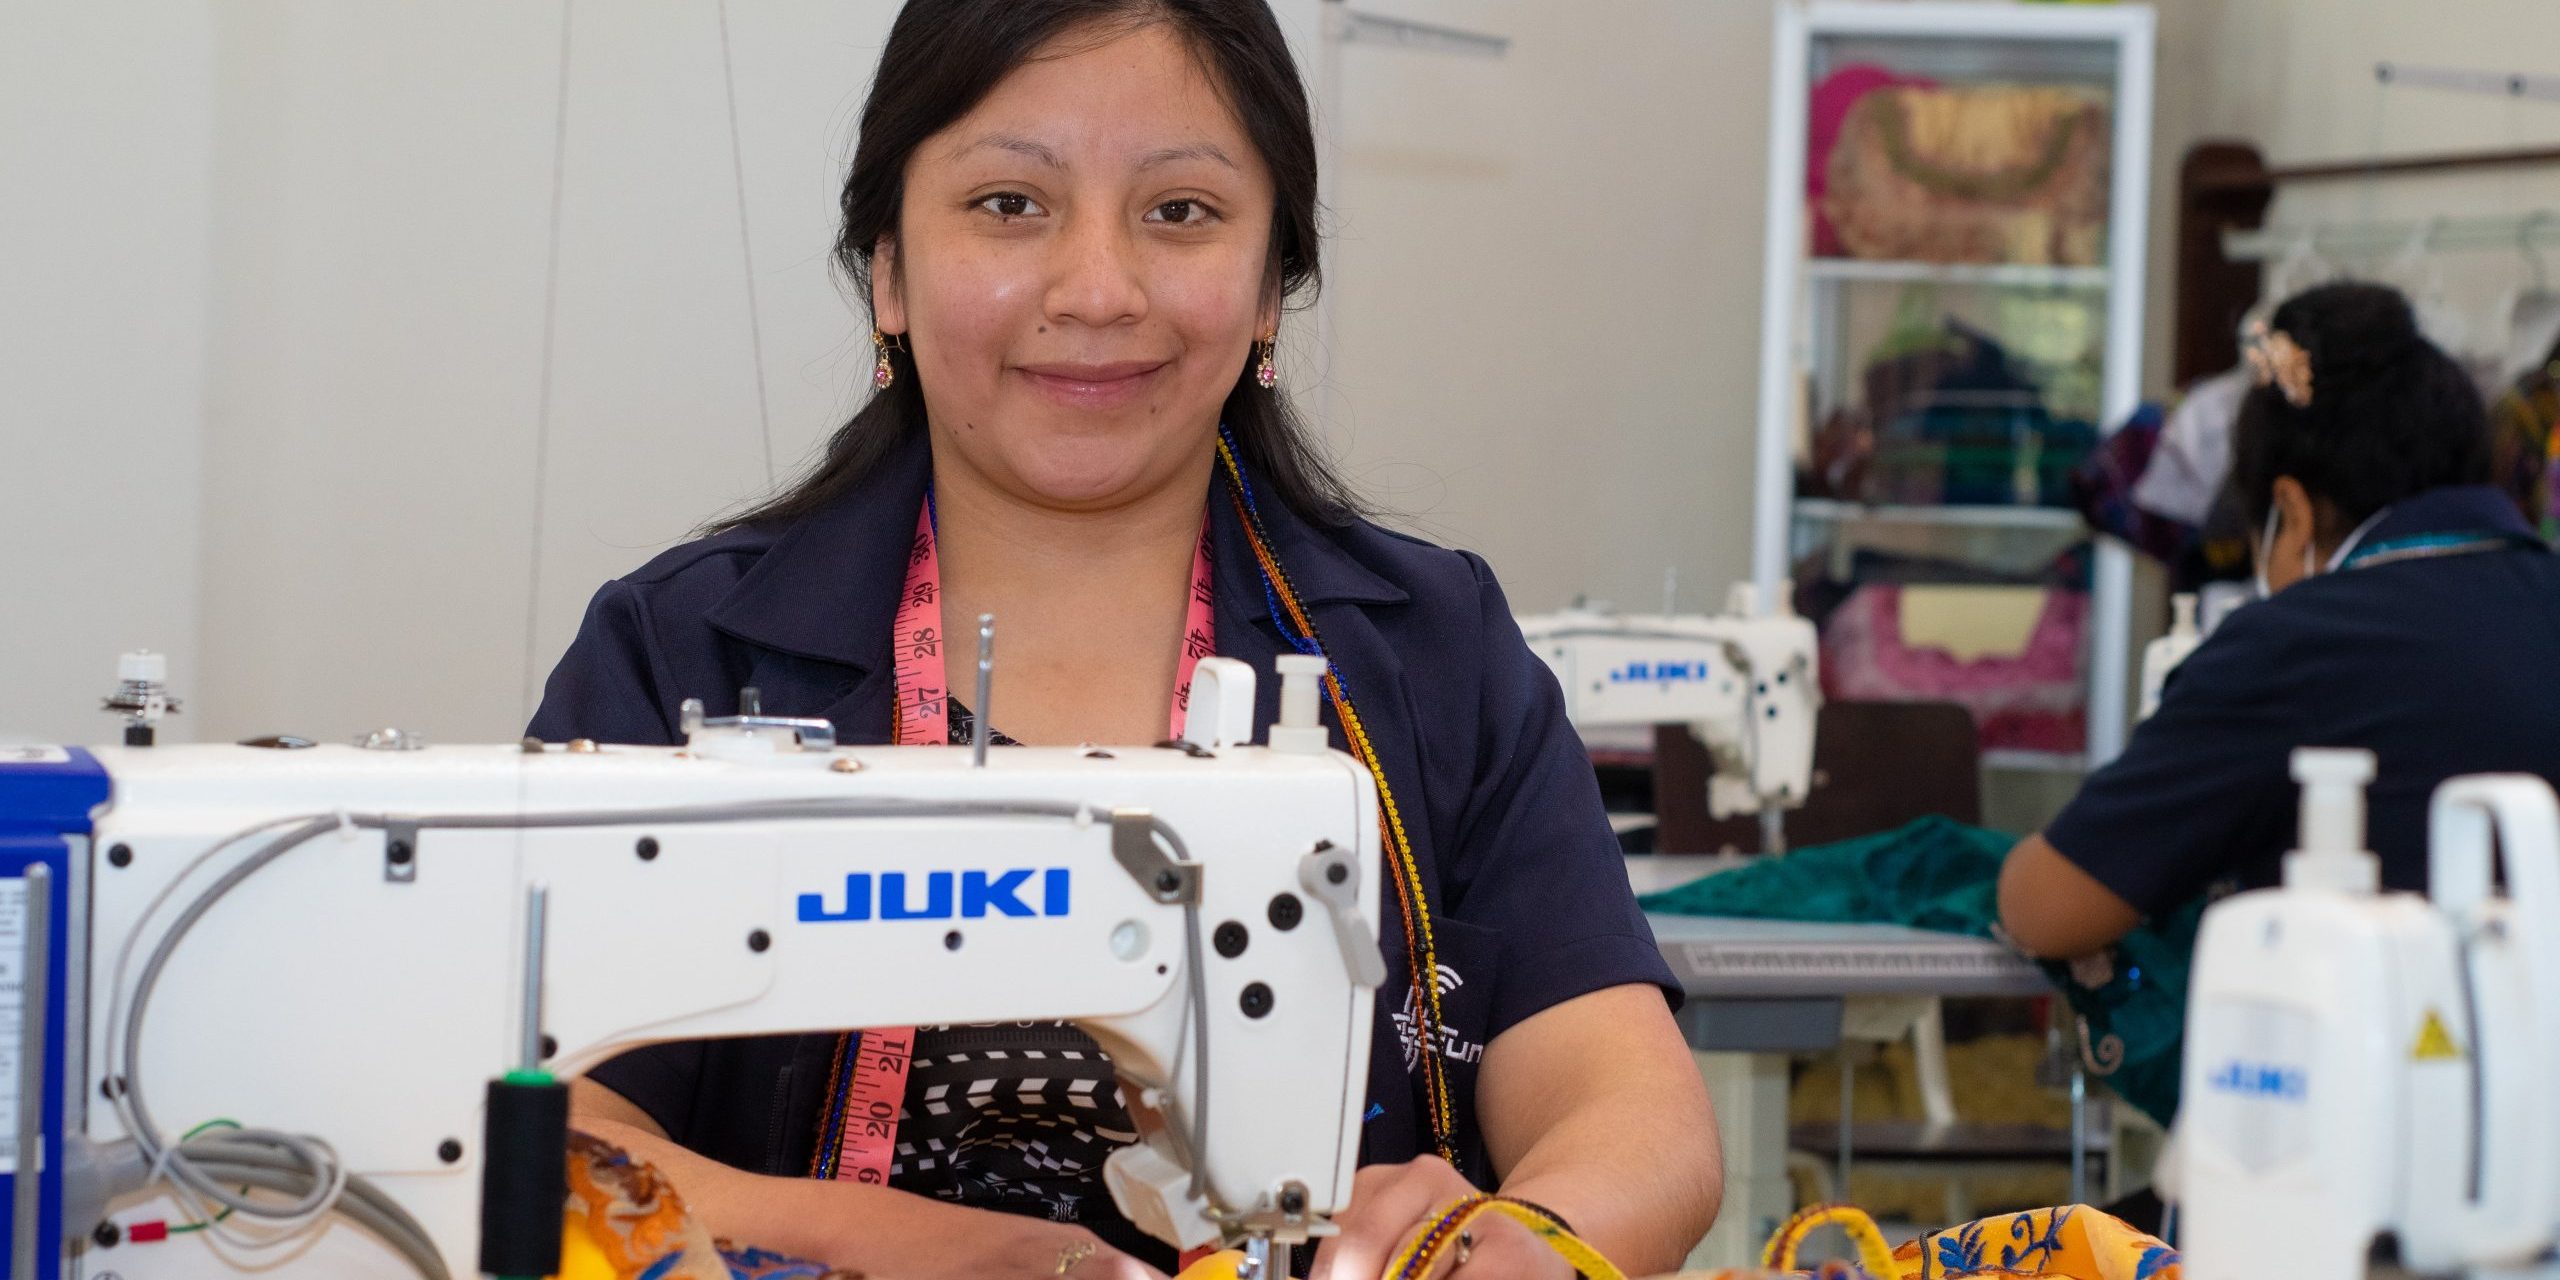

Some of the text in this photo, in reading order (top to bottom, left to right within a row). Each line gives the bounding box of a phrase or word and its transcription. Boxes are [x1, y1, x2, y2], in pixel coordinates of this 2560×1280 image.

[912, 533, 931, 565] 30
[912, 582, 933, 607] 29
[913, 627, 936, 659] 28
[918, 687, 941, 719] 27
[798, 868, 1070, 922] JUKI
[879, 1040, 906, 1074] 21
[866, 1101, 893, 1140] 20
